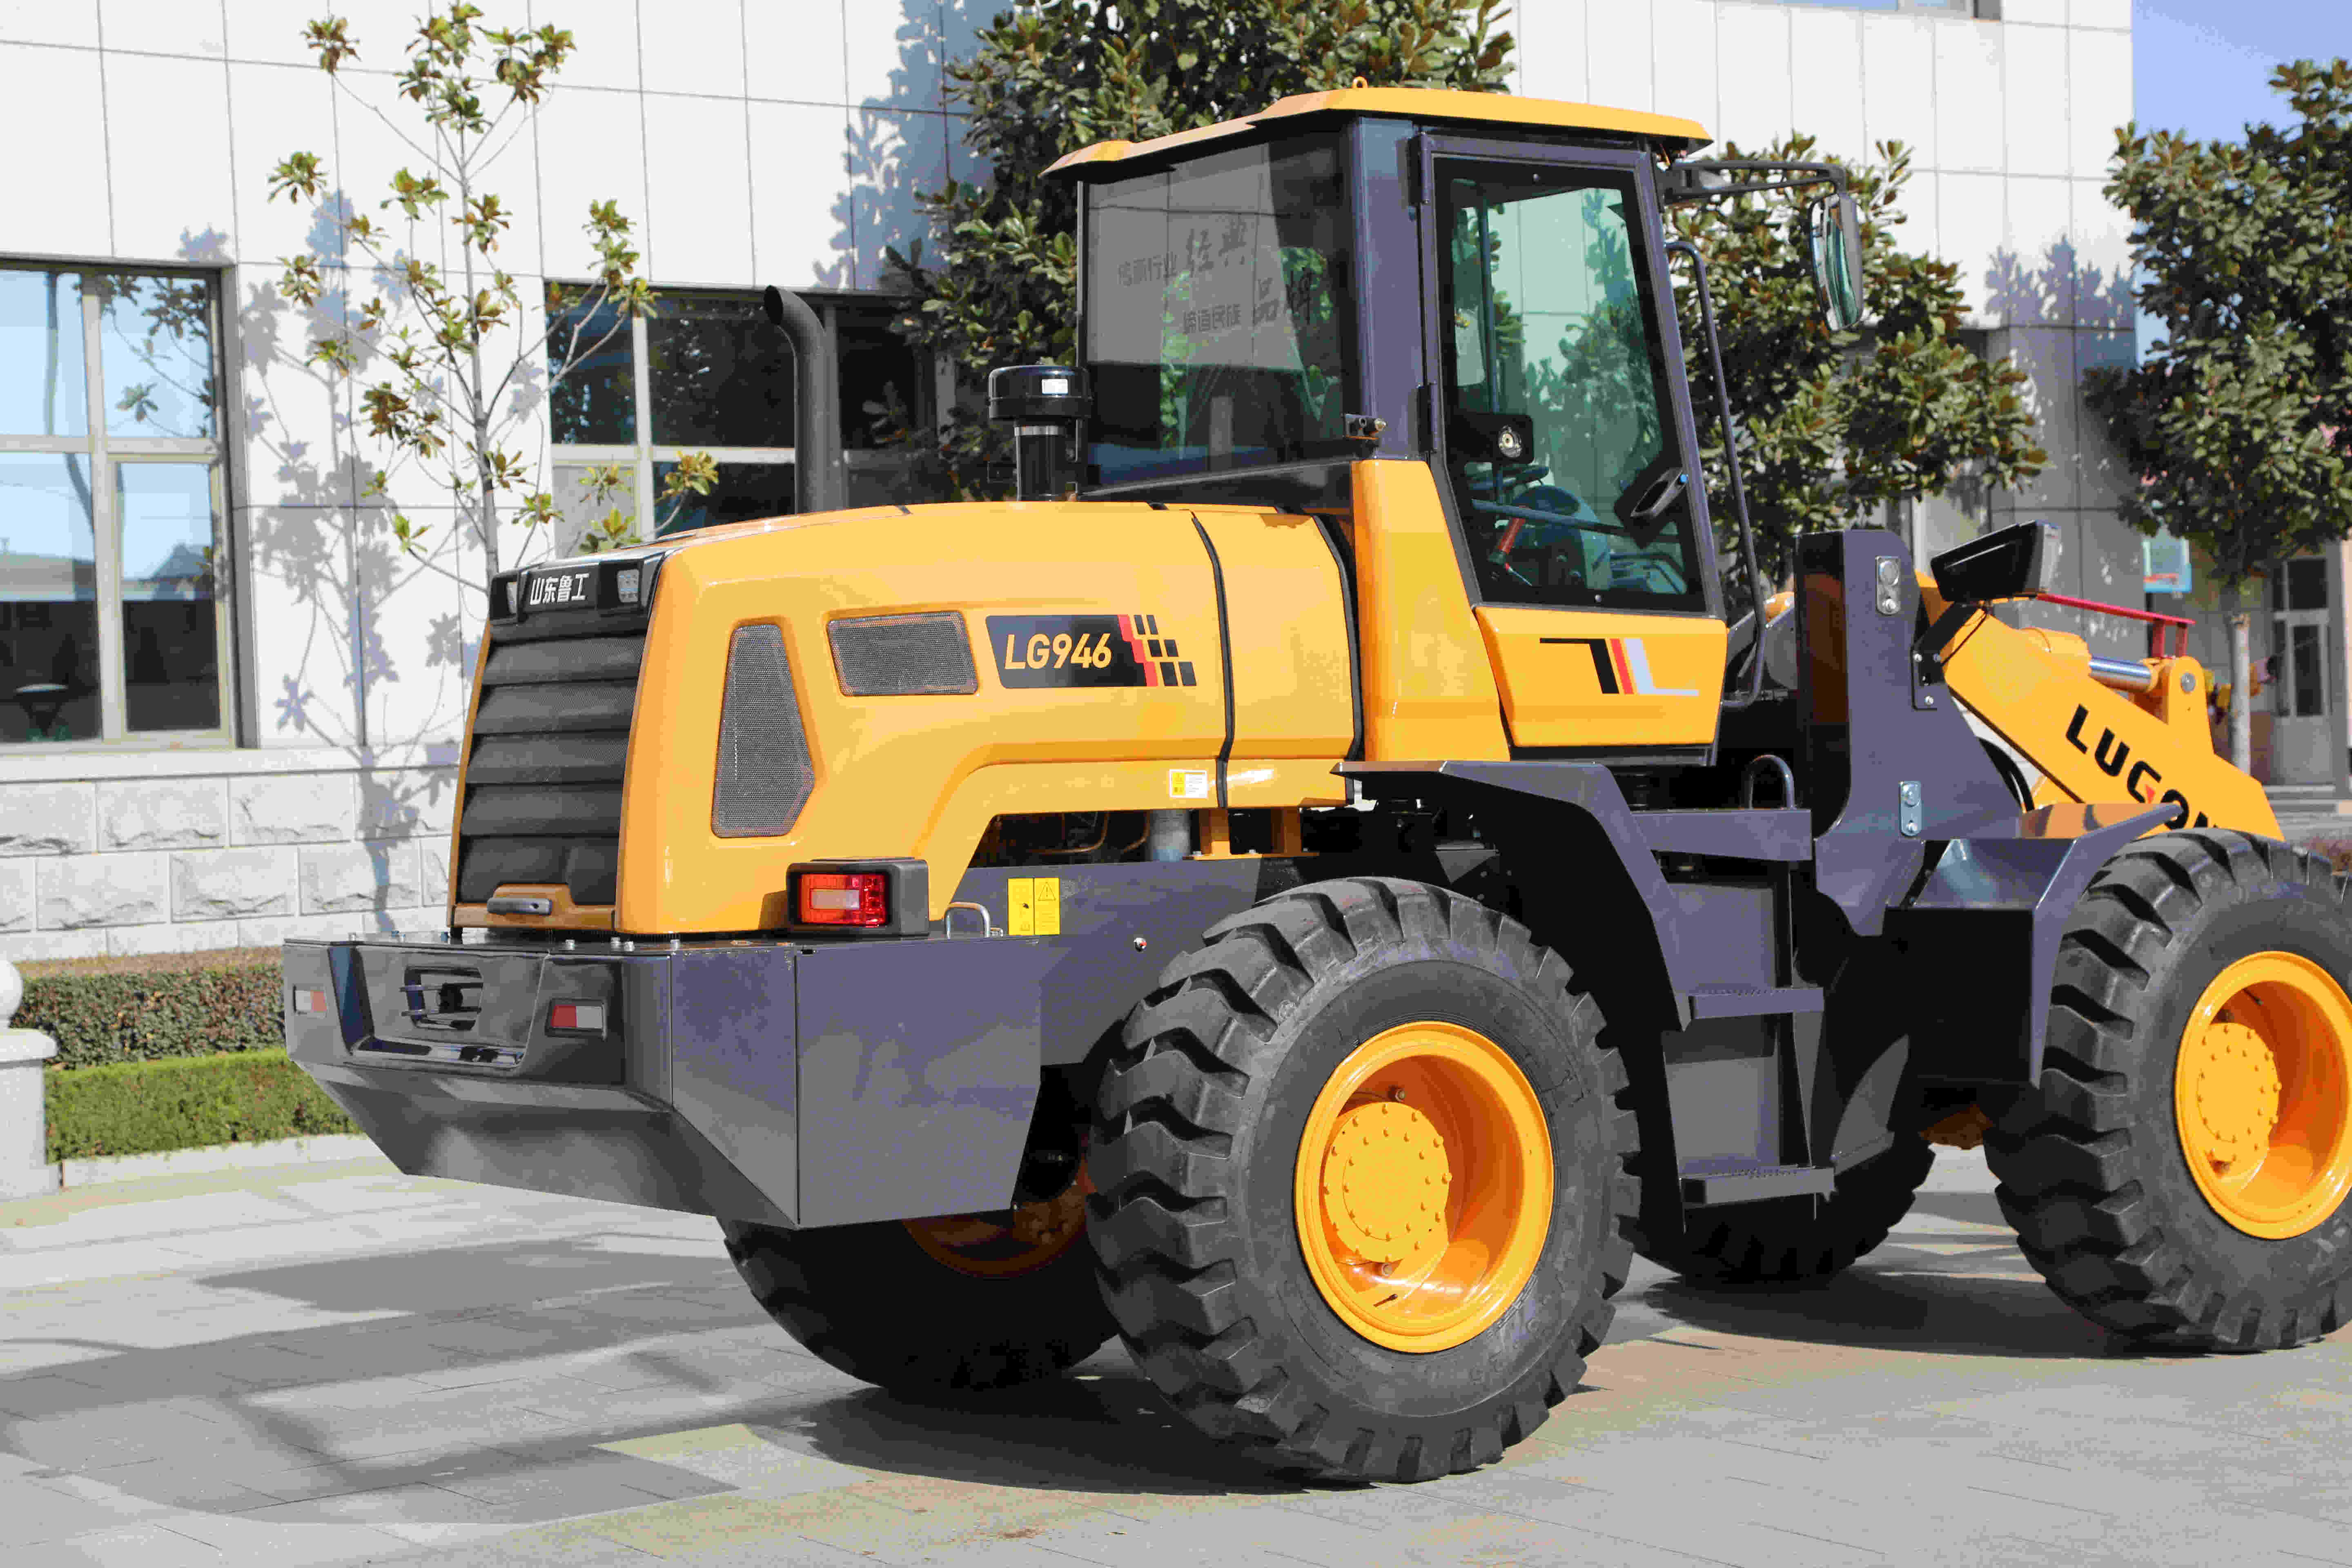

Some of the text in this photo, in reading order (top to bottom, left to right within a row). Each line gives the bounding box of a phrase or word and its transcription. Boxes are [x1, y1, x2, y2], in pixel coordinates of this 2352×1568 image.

[530, 573, 590, 605] 山东鲁工
[1004, 633, 1113, 670] LG946
